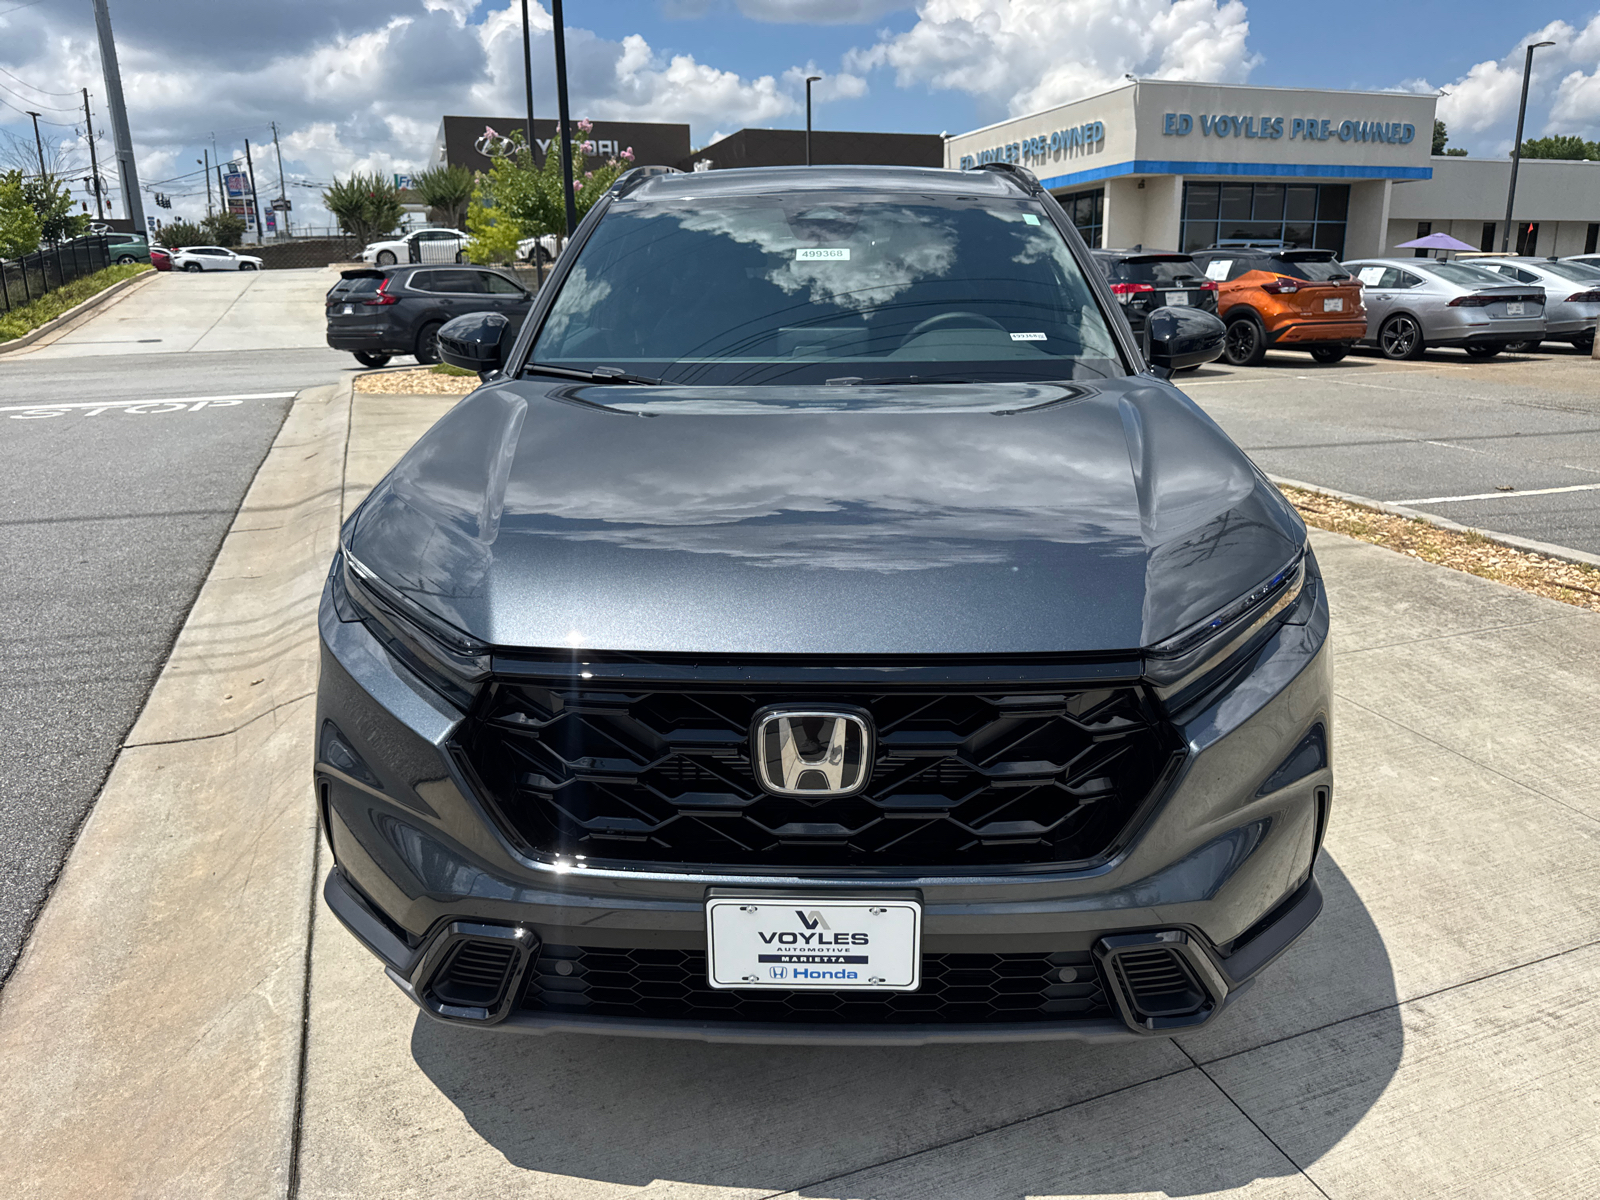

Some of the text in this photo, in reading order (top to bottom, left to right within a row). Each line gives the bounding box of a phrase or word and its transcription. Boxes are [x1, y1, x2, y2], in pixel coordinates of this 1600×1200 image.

[1163, 113, 1416, 145] ED VOYLES PRE-OWNED
[960, 121, 1104, 170] ED VOYLES PRE-OWNED
[802, 250, 843, 258] 499368
[9, 399, 244, 420] STOP
[758, 931, 869, 945] VOYLES
[793, 968, 858, 979] Honda
